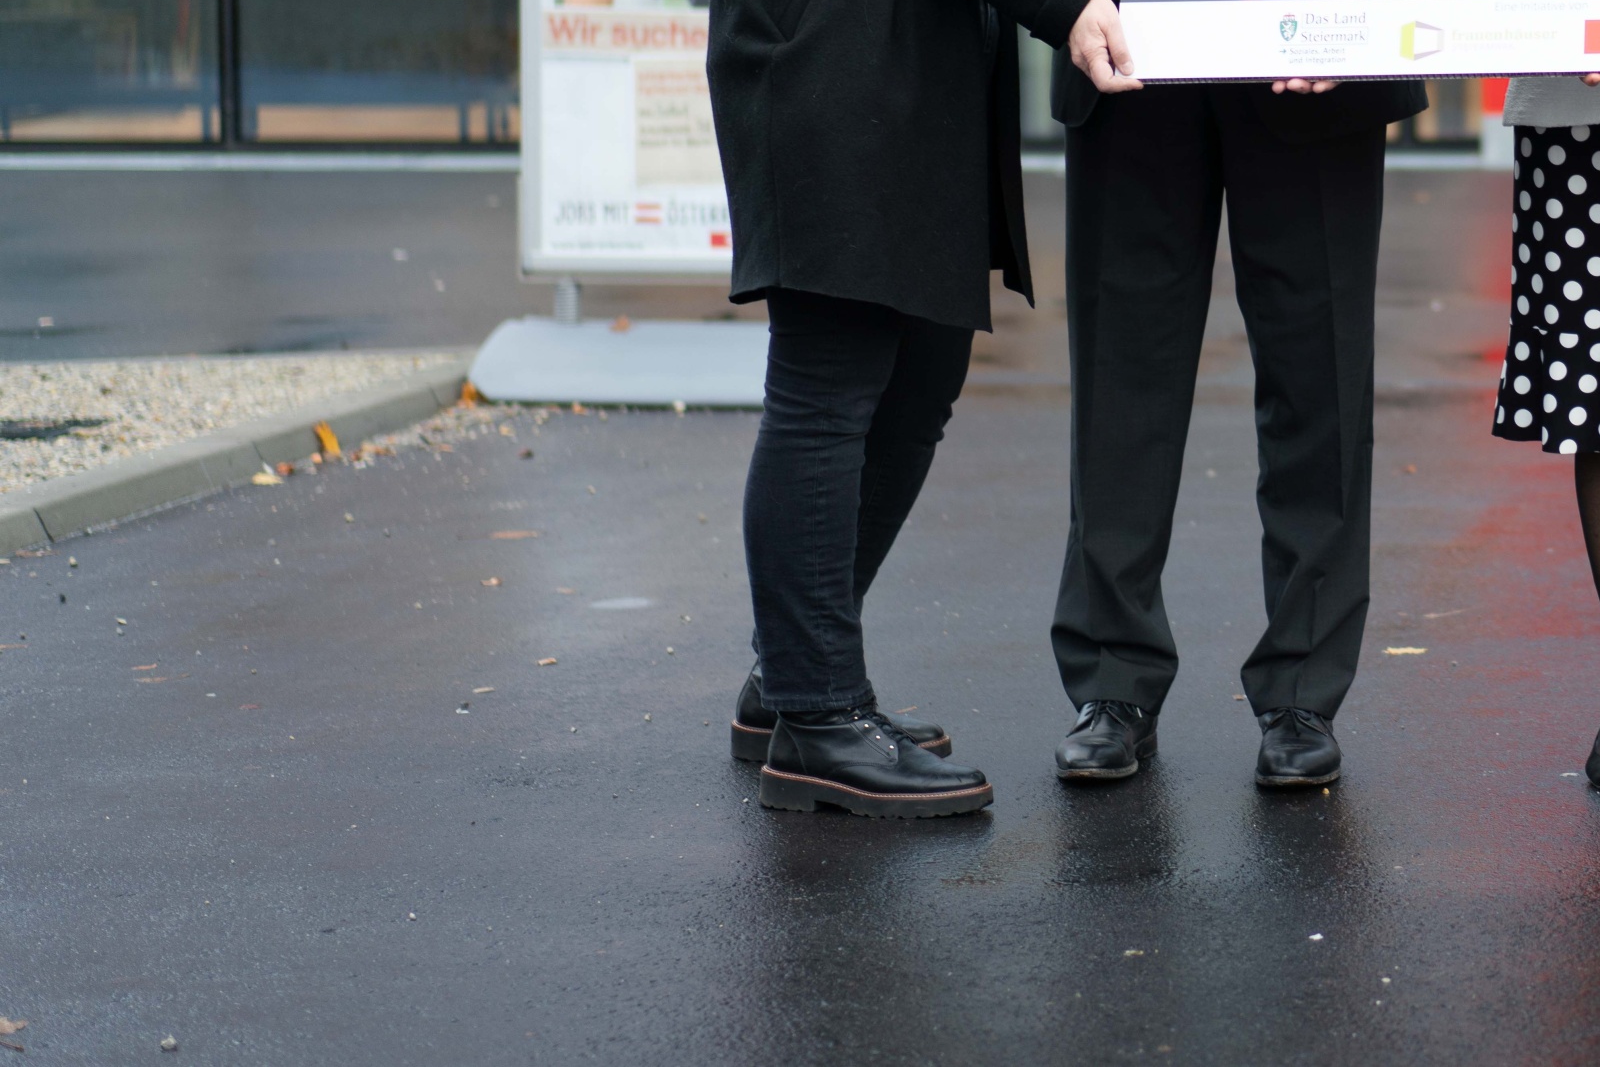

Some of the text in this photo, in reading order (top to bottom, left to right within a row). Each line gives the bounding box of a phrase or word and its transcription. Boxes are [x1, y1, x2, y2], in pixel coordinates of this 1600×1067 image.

[1305, 11, 1366, 24] Das Land
[547, 15, 602, 44] Wir
[1300, 30, 1366, 43] Steiermark
[1323, 47, 1345, 55] Arbeit
[1289, 56, 1303, 64] und
